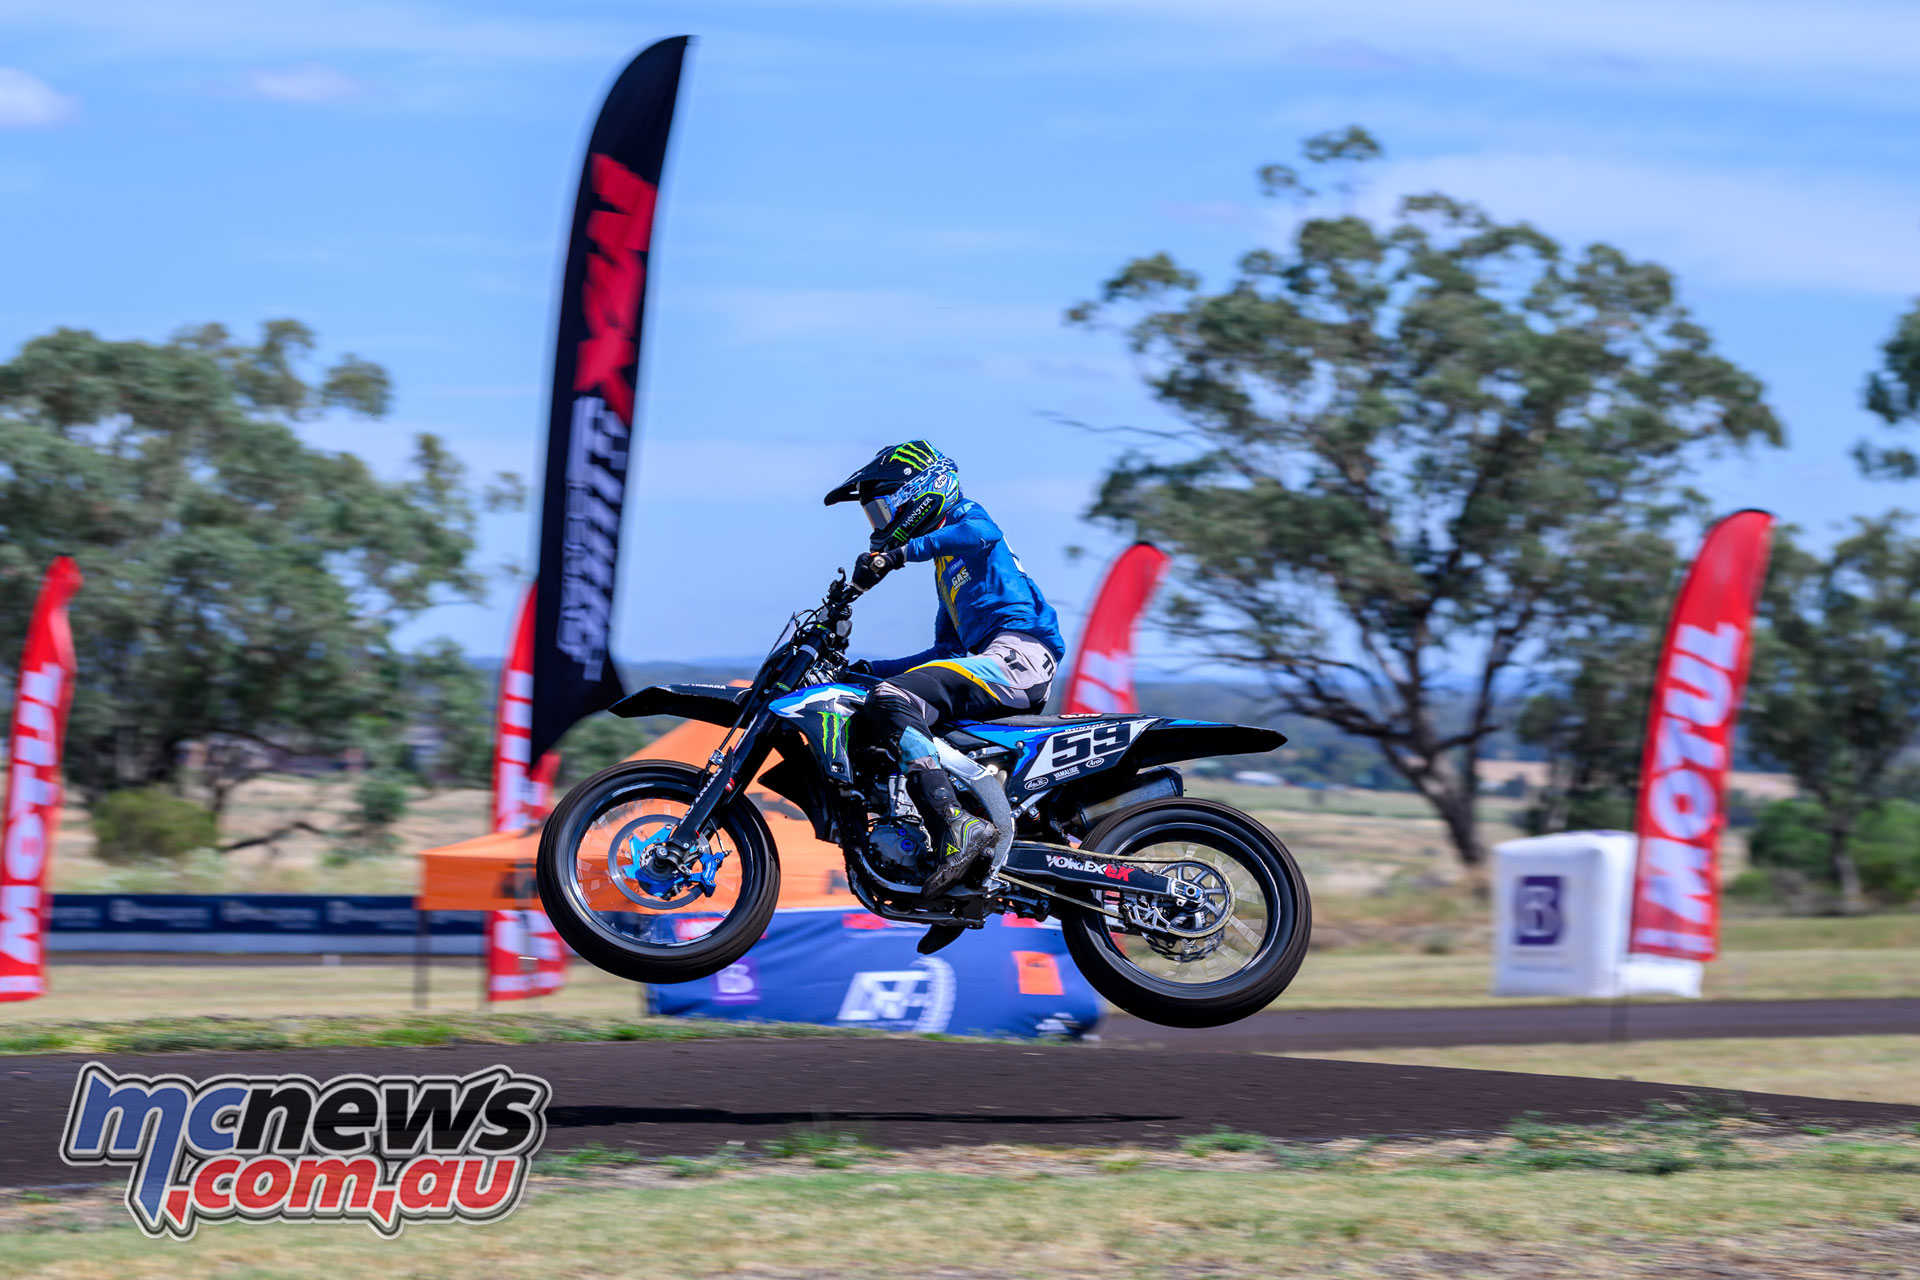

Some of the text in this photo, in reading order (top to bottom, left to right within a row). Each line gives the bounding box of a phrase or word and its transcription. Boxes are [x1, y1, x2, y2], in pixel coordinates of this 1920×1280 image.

[902, 496, 933, 528] MONSTER
[951, 568, 970, 587] GAS
[1052, 723, 1131, 768] 59
[1053, 766, 1080, 778] YAMALUBE
[1642, 622, 1743, 925] MOTUL
[0, 661, 65, 965] MOTUL
